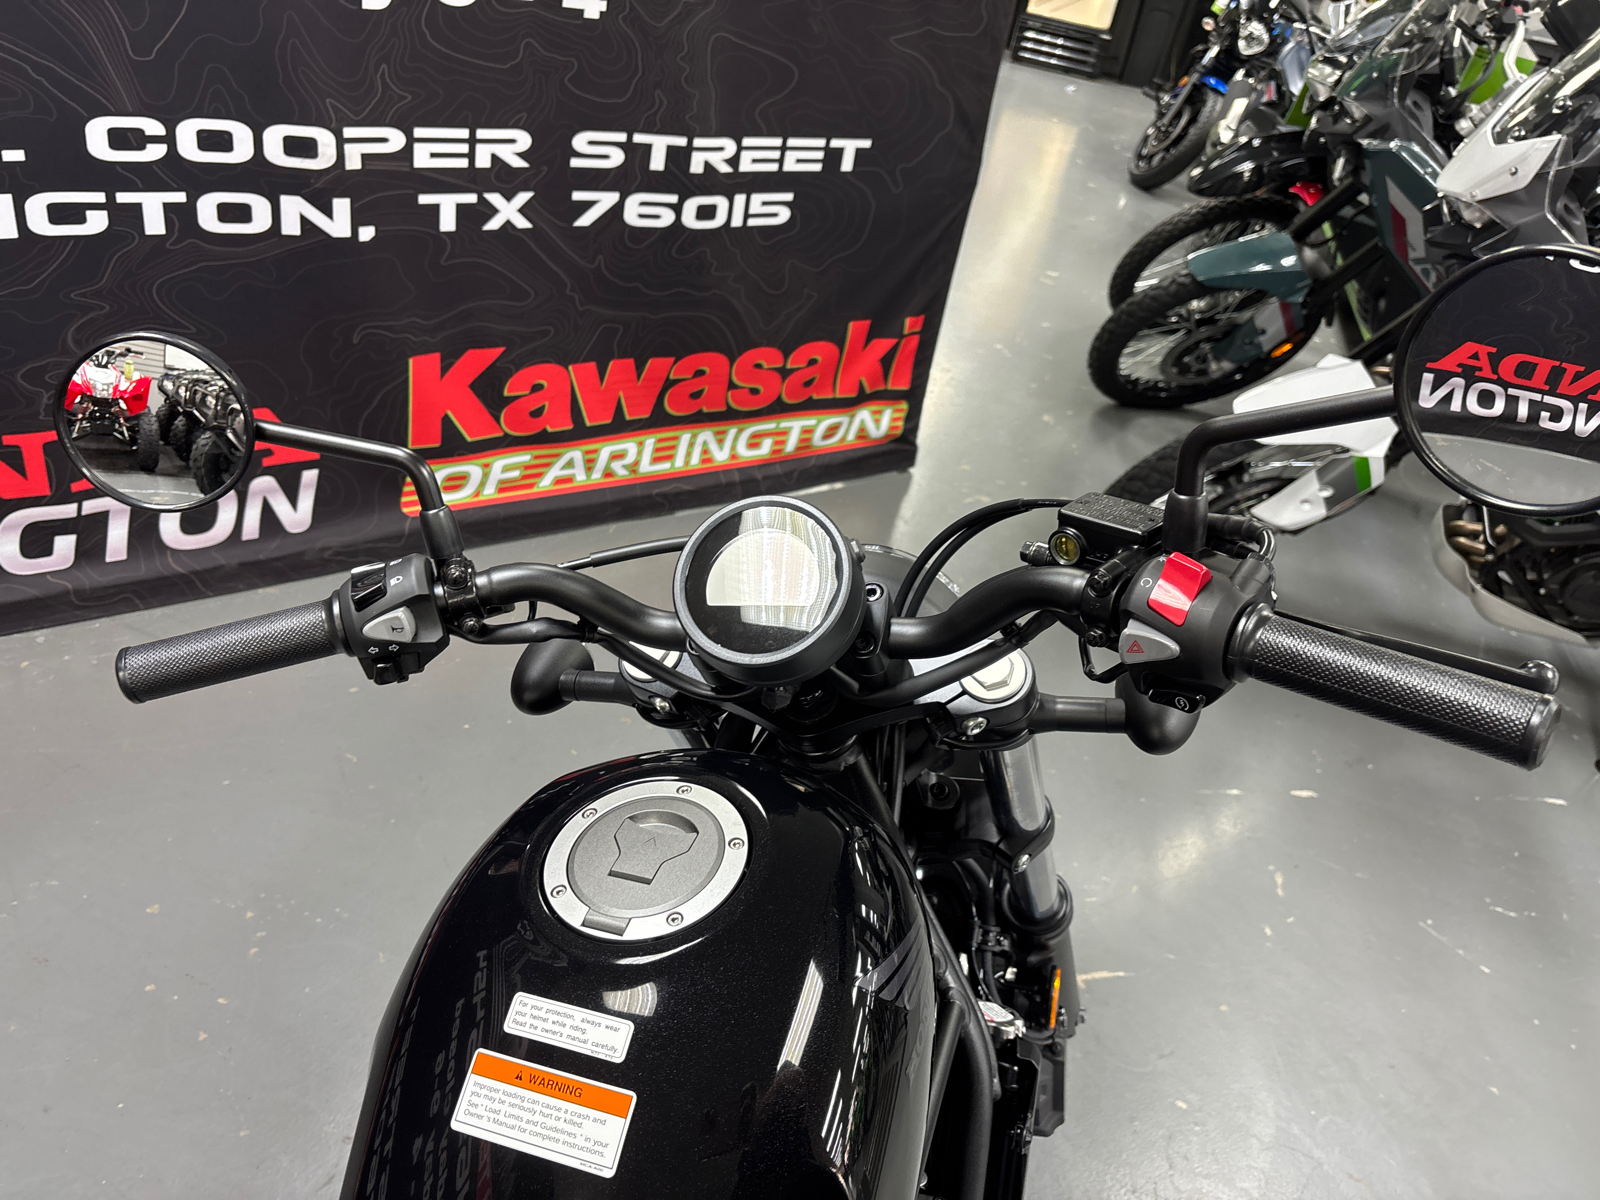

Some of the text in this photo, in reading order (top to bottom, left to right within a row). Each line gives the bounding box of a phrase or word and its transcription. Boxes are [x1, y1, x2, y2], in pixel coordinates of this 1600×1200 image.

[84, 115, 873, 175] COOPER STREET
[417, 190, 535, 233] TX
[571, 190, 795, 230] 76015
[408, 314, 926, 449] Kawasaki
[436, 408, 893, 501] OF ARLINGTON
[511, 1017, 528, 1028] Read
[528, 1023, 539, 1031] the
[540, 1027, 564, 1038] owner's
[565, 1034, 590, 1045] manual
[591, 1041, 619, 1055] carefully.
[514, 1010, 588, 1036] your helmet while riding.
[518, 999, 621, 1033] For your protection, always wear
[473, 1080, 501, 1094] Improper
[501, 1089, 527, 1104] loading
[526, 1097, 541, 1106] can
[540, 1102, 563, 1113] cause
[570, 1110, 591, 1122] crash
[591, 1117, 607, 1126] and
[529, 1073, 584, 1099] WARNING
[466, 1099, 480, 1110] See
[503, 1110, 524, 1123] Limits
[524, 1118, 540, 1128] and
[591, 1139, 610, 1149] your
[469, 1090, 482, 1099] you
[482, 1094, 497, 1105] may
[497, 1097, 507, 1106] be
[508, 1101, 538, 1117] seriously
[538, 1109, 554, 1120] hurt
[563, 1116, 584, 1129] killed.
[491, 1117, 518, 1131] Manual
[517, 1125, 529, 1134] for
[528, 1129, 561, 1145] complete
[561, 1140, 606, 1159] instructions.
